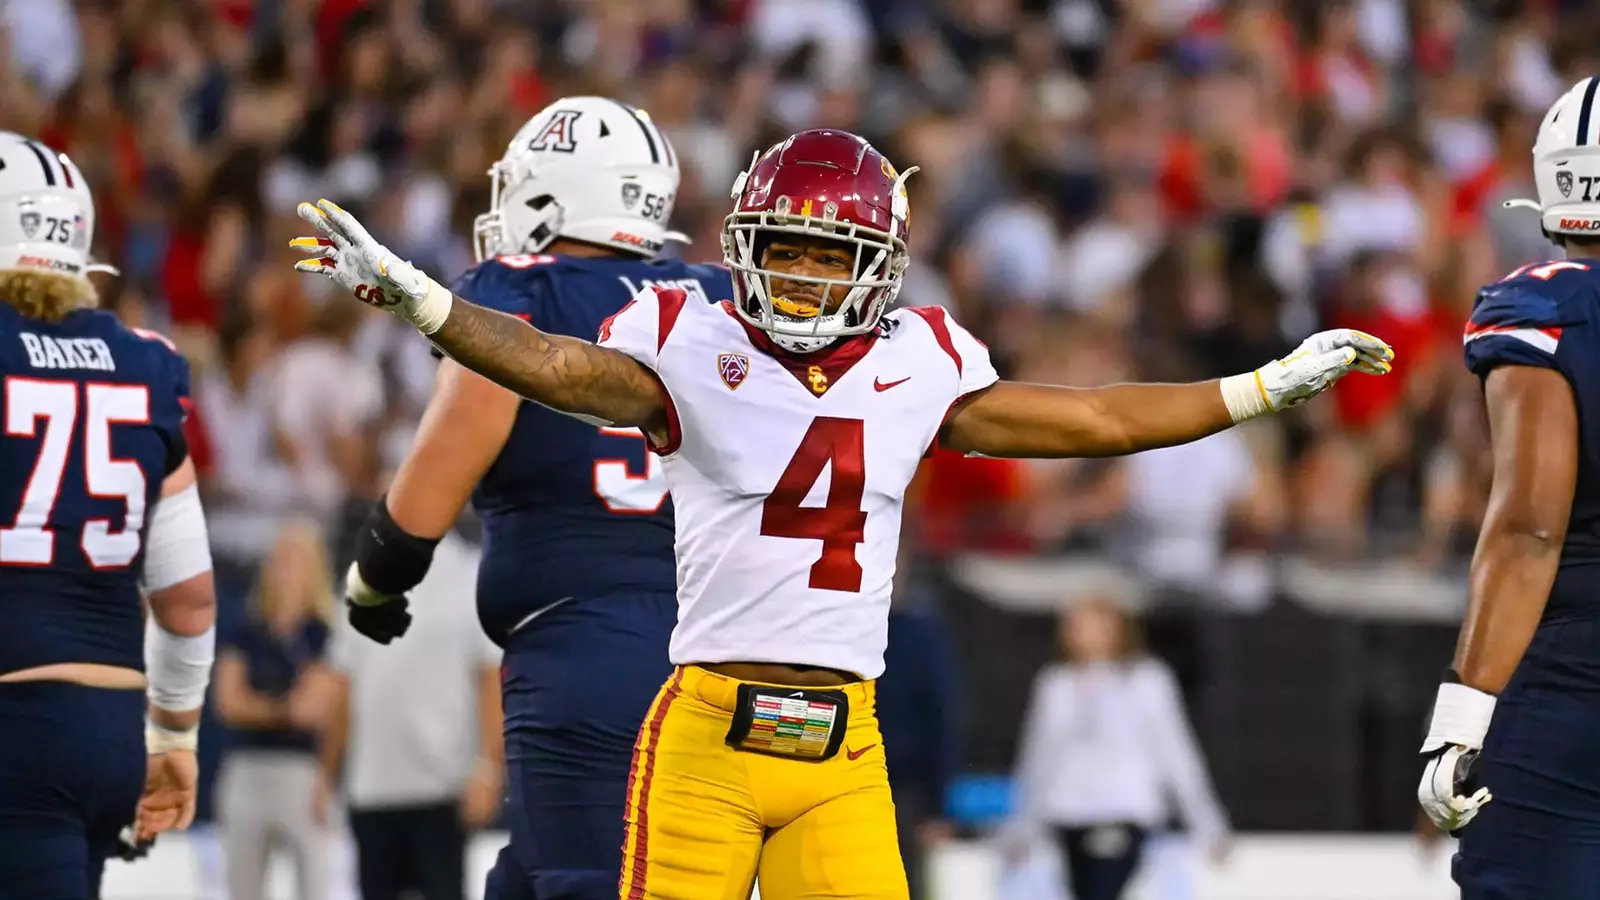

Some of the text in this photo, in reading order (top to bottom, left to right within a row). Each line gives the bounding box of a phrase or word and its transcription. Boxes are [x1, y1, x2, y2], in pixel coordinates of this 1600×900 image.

[641, 192, 665, 220] 58
[46, 216, 72, 243] 75
[19, 332, 116, 372] BAKER
[725, 368, 741, 383] 12
[808, 365, 828, 393] SC
[0, 375, 149, 569] 75
[760, 416, 868, 593] 4
